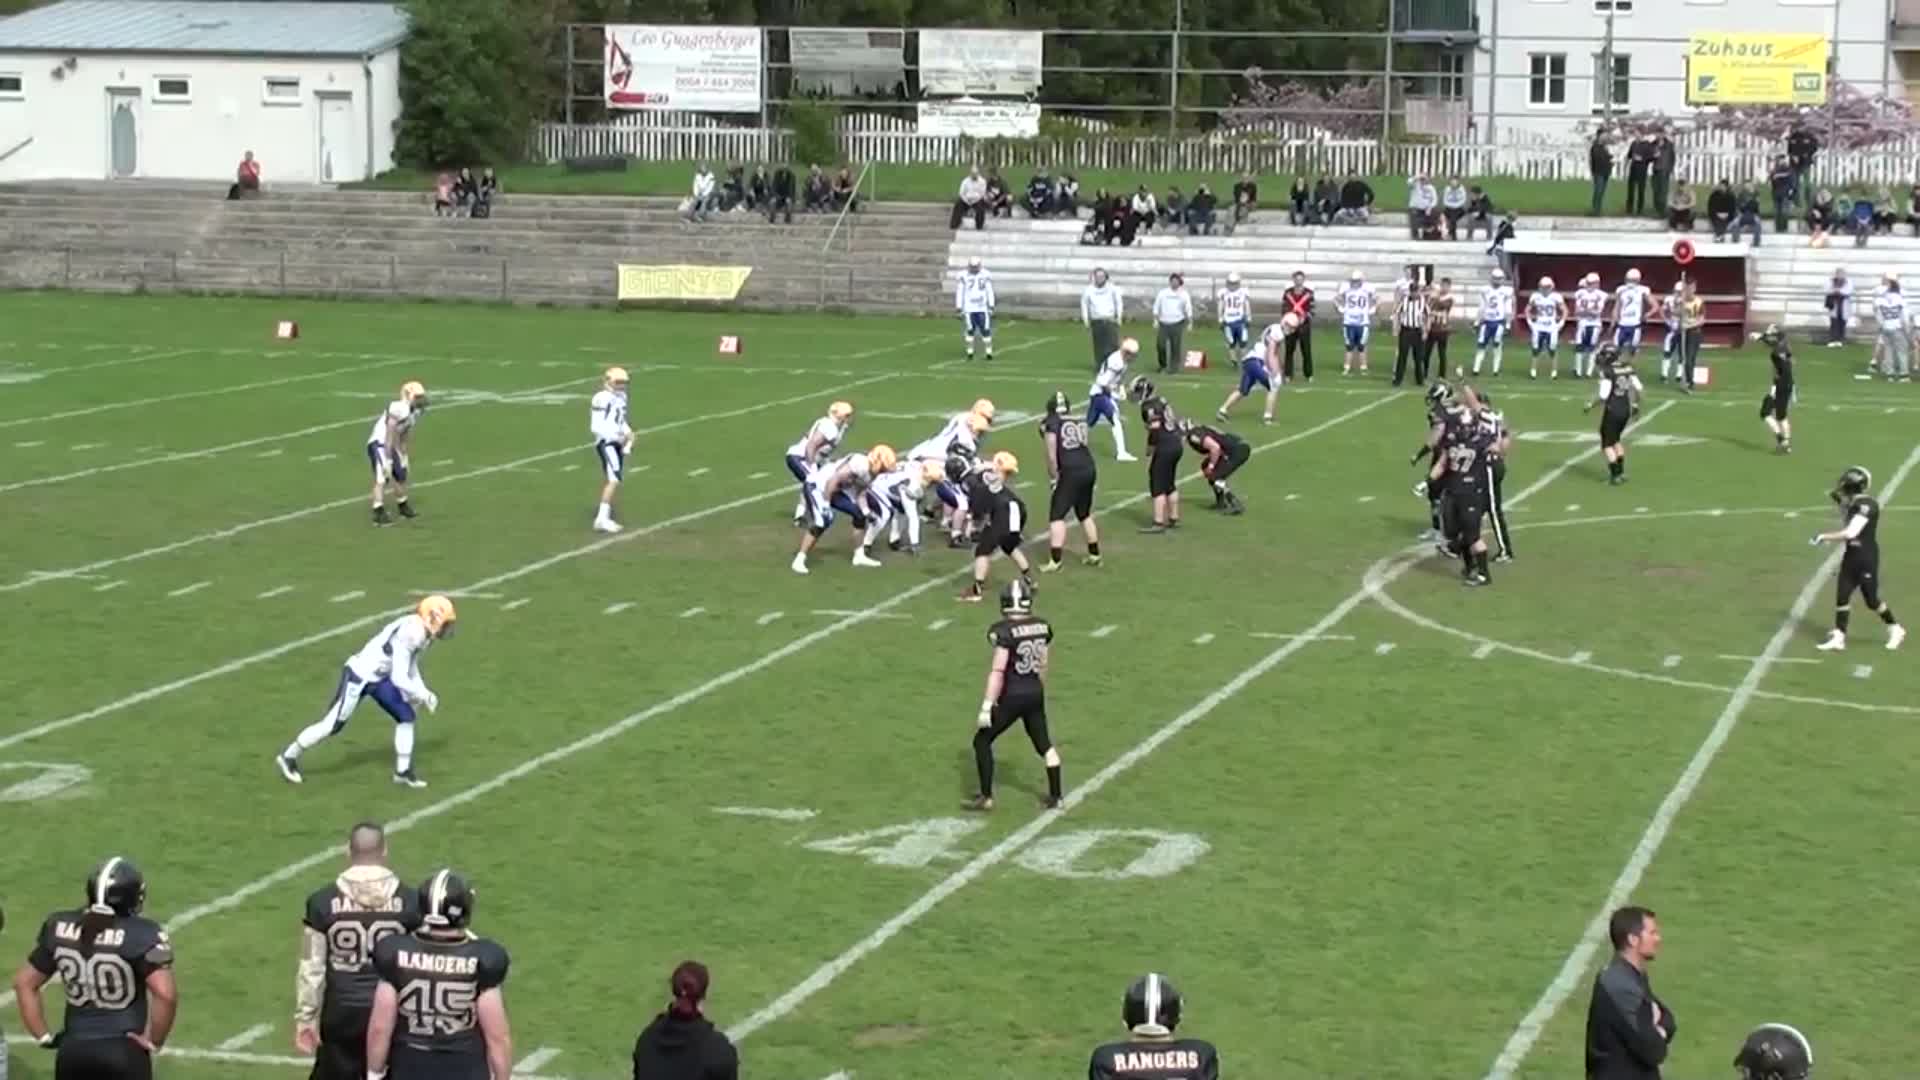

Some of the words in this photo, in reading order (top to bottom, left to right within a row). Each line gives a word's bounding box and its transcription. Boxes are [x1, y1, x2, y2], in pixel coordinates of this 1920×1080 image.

[1694, 38, 1774, 57] Zuhaus
[397, 950, 479, 974] RANGERS
[399, 978, 478, 1035] 45
[1113, 1050, 1200, 1073] RANGERS
